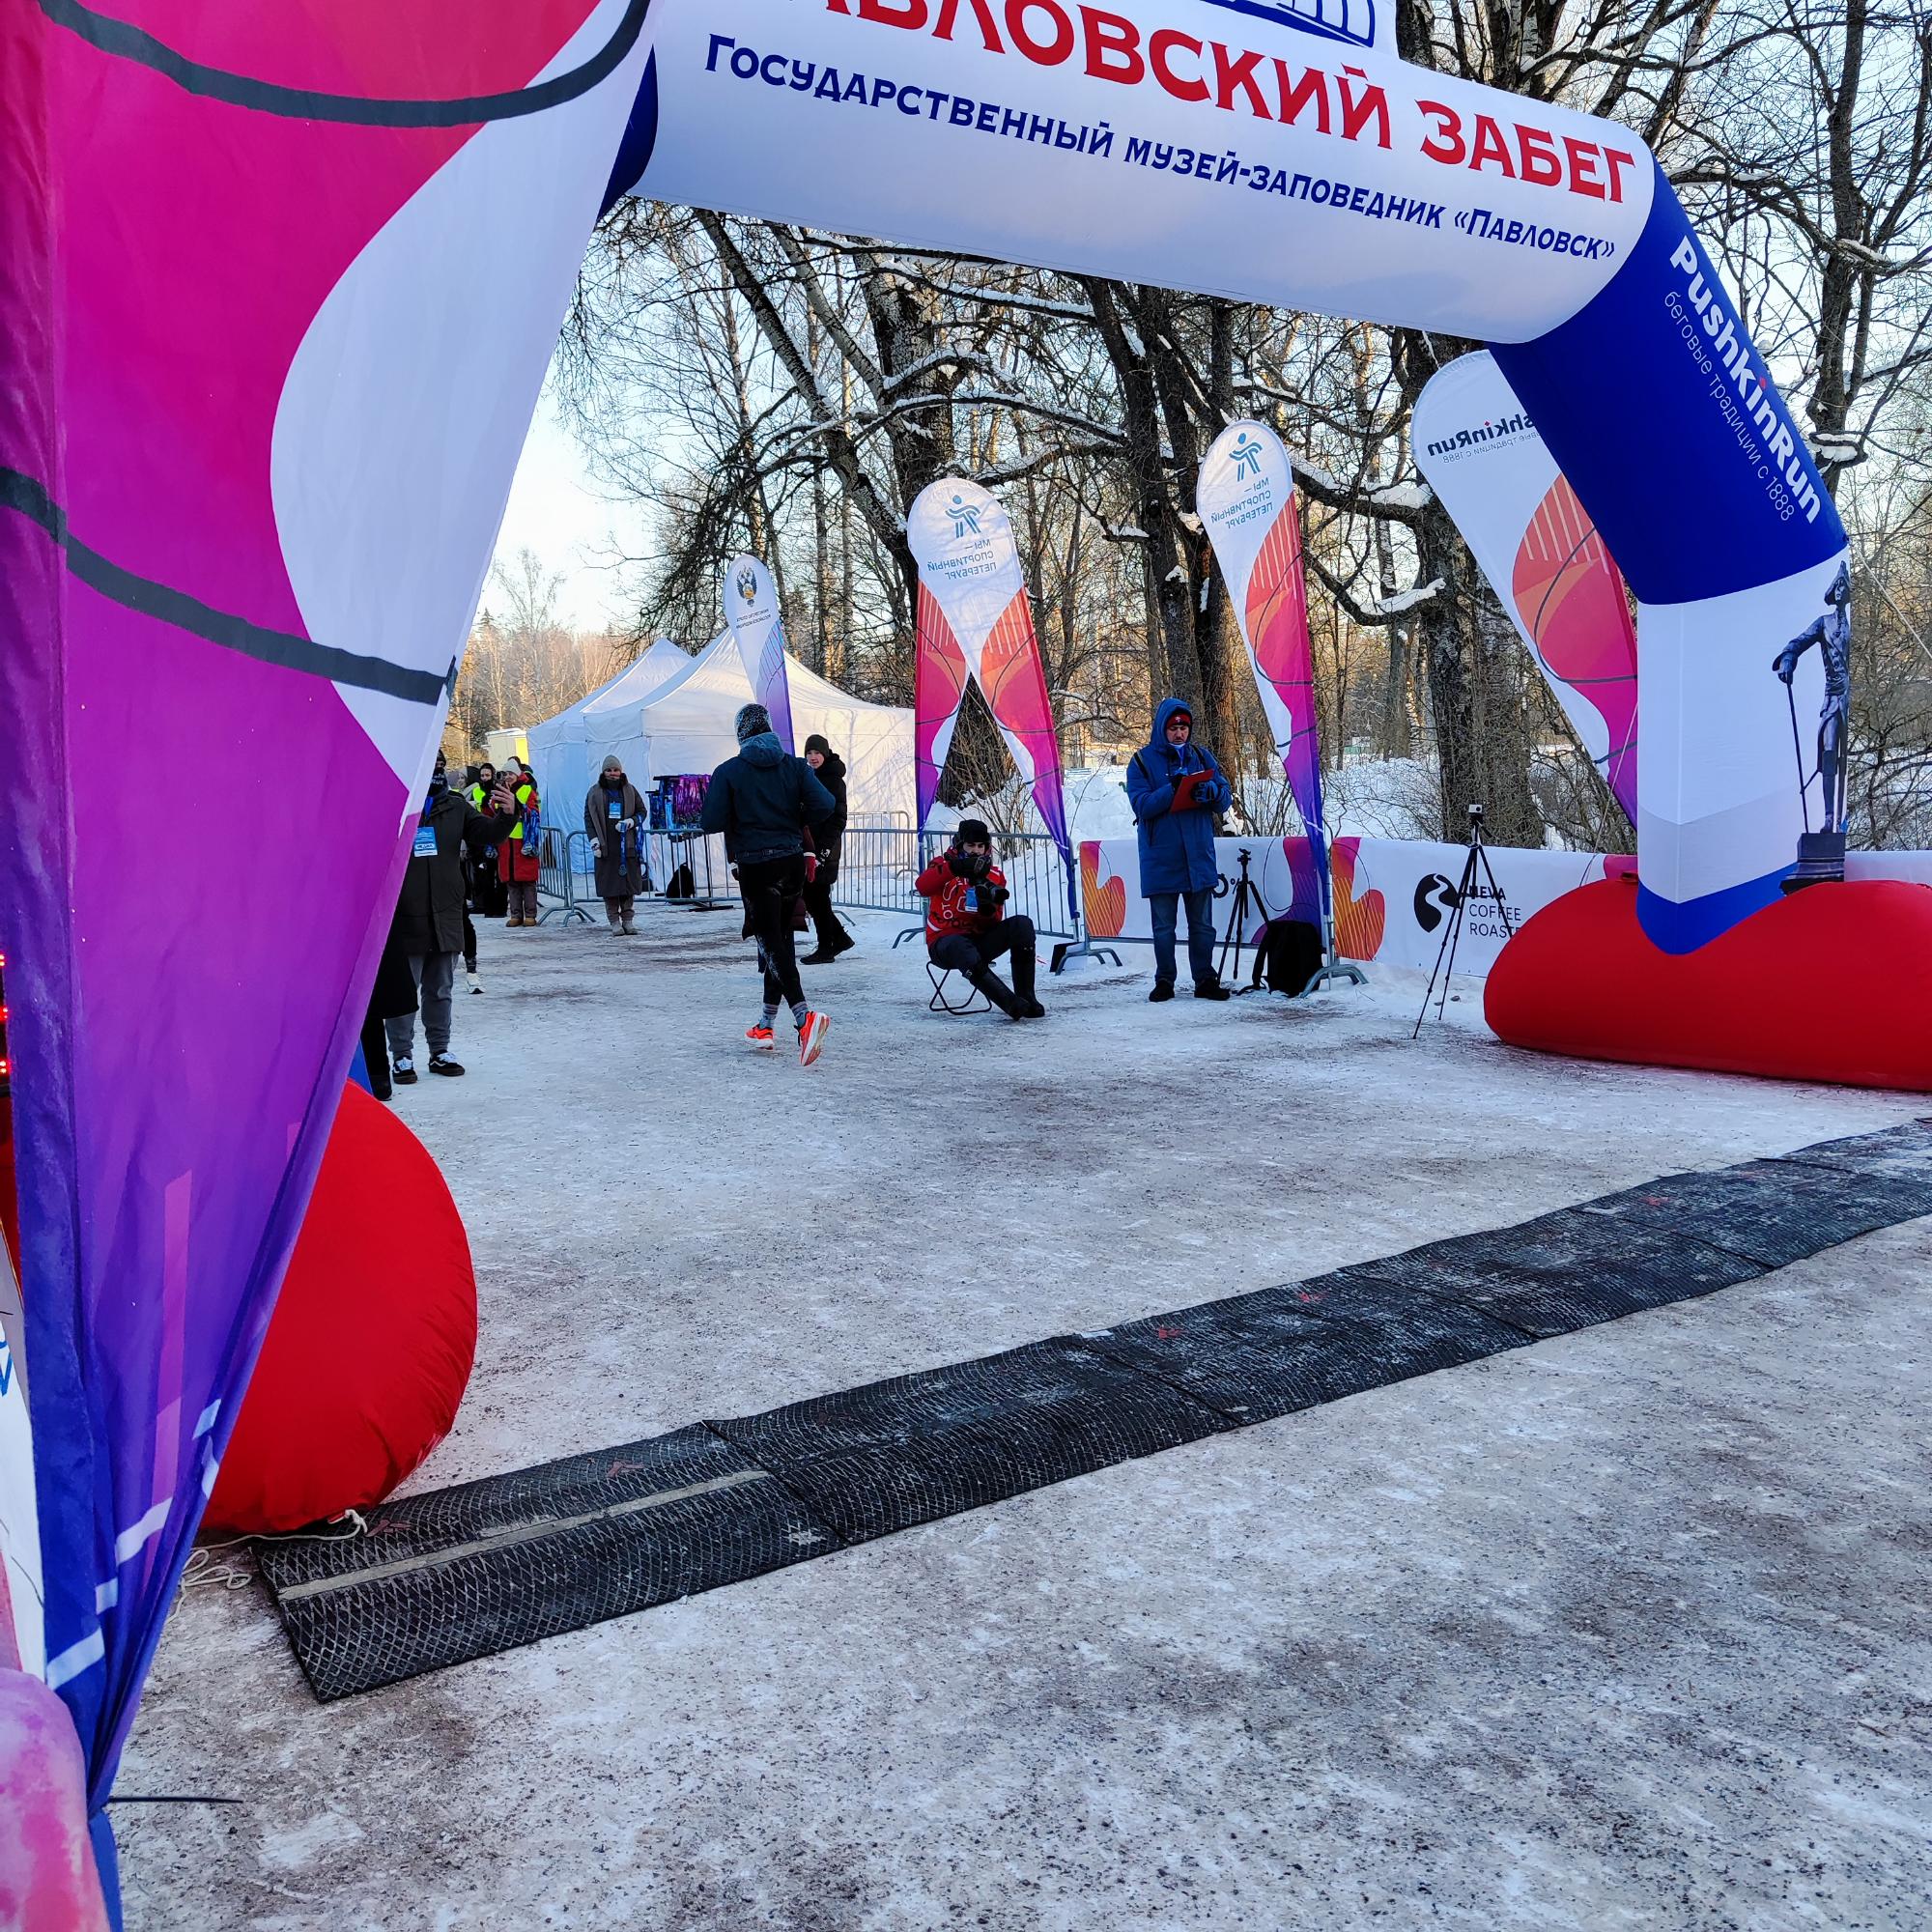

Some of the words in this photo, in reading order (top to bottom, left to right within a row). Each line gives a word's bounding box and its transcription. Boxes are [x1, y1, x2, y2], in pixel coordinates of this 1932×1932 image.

[705, 33, 1115, 158] ГОСУДАРСТВЕННЫЙ
[1124, 136, 1447, 229] МУЗЕЙ-ЗАПОВЕДНИК
[1417, 99, 1635, 203] ЗАБЕГ
[1664, 291, 1713, 373] беговые
[1709, 373, 1762, 465] традиции
[1757, 465, 1769, 479] с
[1766, 476, 1795, 521] 1888
[1669, 235, 1821, 524] PushkinRun
[1469, 903, 1521, 922] COFFEE
